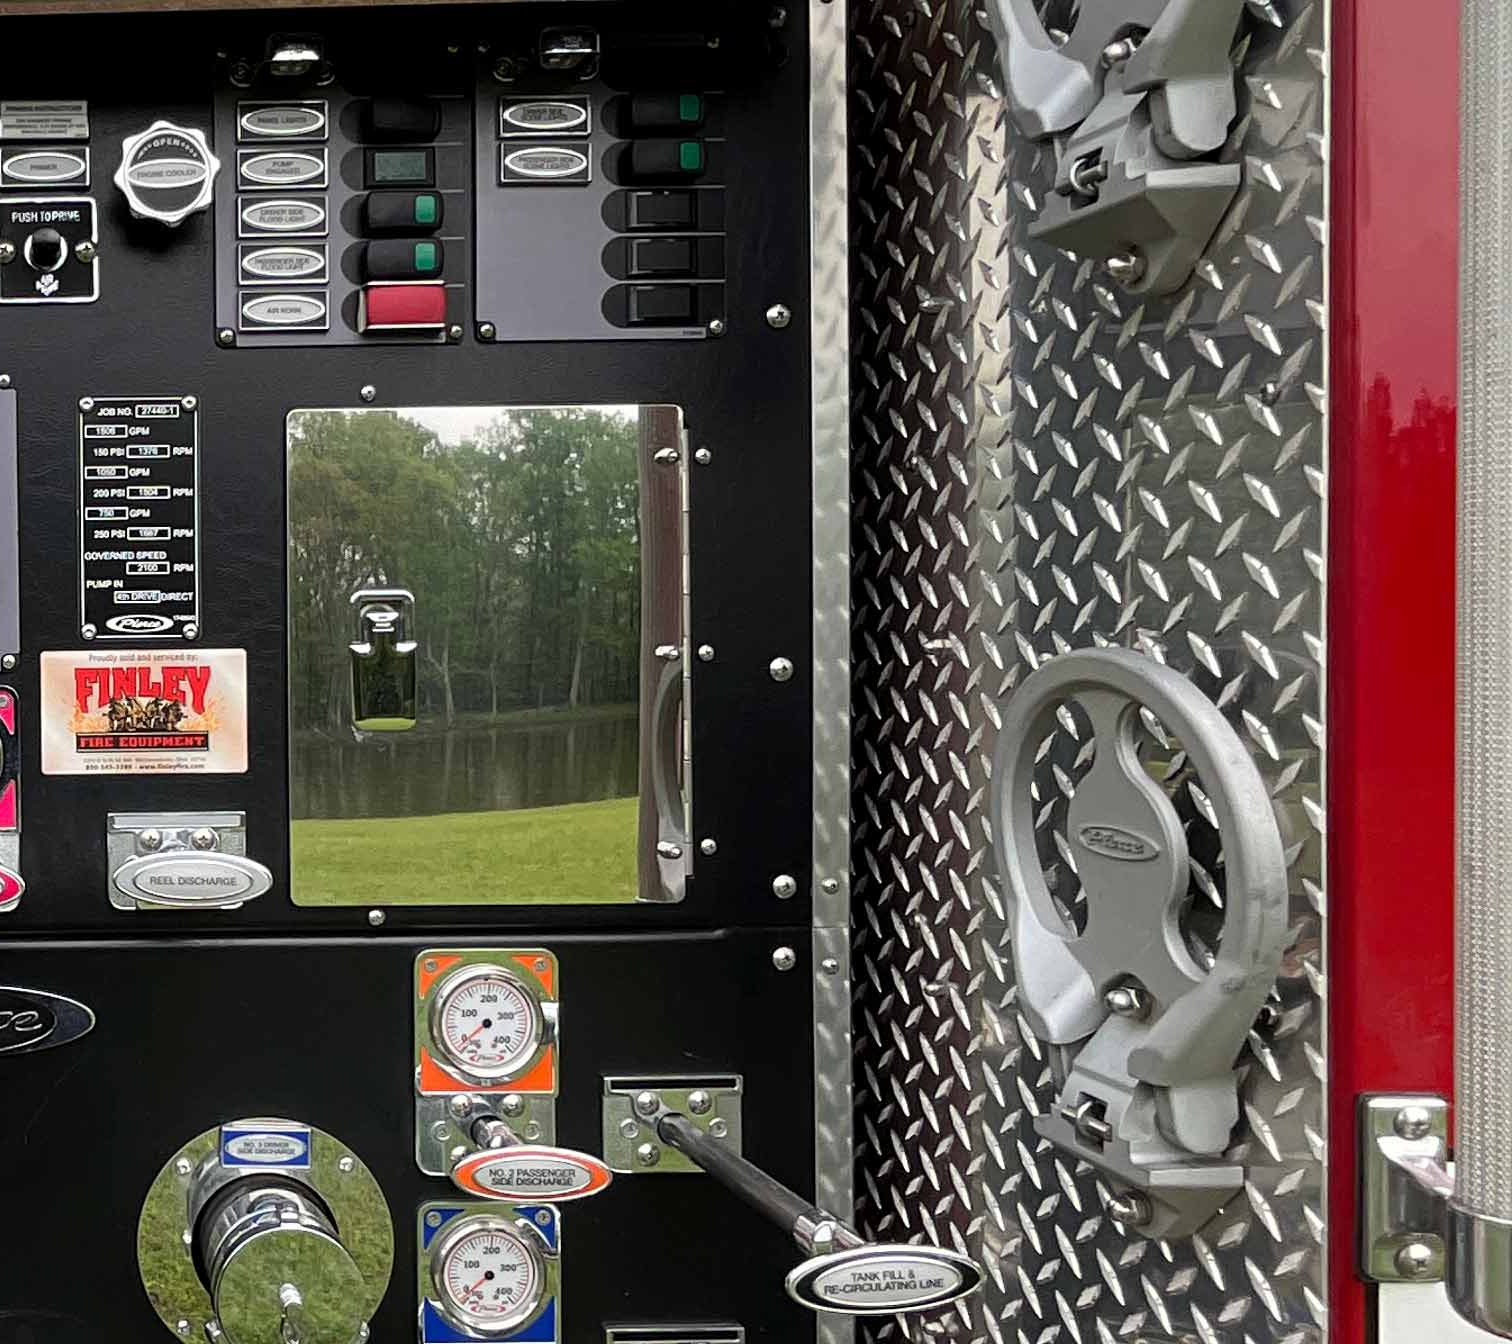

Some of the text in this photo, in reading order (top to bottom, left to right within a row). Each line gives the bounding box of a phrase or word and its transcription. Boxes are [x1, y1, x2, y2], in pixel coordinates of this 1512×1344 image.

[153, 137, 180, 147] OPEN
[12, 212, 38, 223] PUSH
[41, 211, 50, 222] TO
[98, 408, 115, 416] JOB
[129, 427, 150, 436] GPM
[110, 447, 193, 456] PSI RPM
[129, 468, 150, 477] GPM
[93, 488, 193, 498] 200 PSI RPM
[129, 509, 150, 518] GPM
[111, 529, 193, 538] PSI RPM
[84, 551, 167, 560] GOVERNED SPEED
[173, 563, 194, 572] RPM
[87, 580, 123, 588] PUMP IN
[131, 592, 193, 601] DRIVE DIRECT
[75, 666, 211, 715] FINLEY
[80, 736, 205, 748] FIRE EQUIPMENT
[150, 876, 237, 886] REEL DISCHARGE
[480, 994, 497, 1003] 200
[461, 1009, 478, 1018] 100
[488, 1169, 576, 1178] NO. PASSENGER
[491, 1177, 574, 1186] SIDE DISCHARGE
[483, 1246, 500, 1255] 200
[464, 1260, 480, 1269] 100
[851, 1269, 916, 1282] TANK FILL &
[824, 1278, 944, 1296] RE-CIRCULATING LINE
